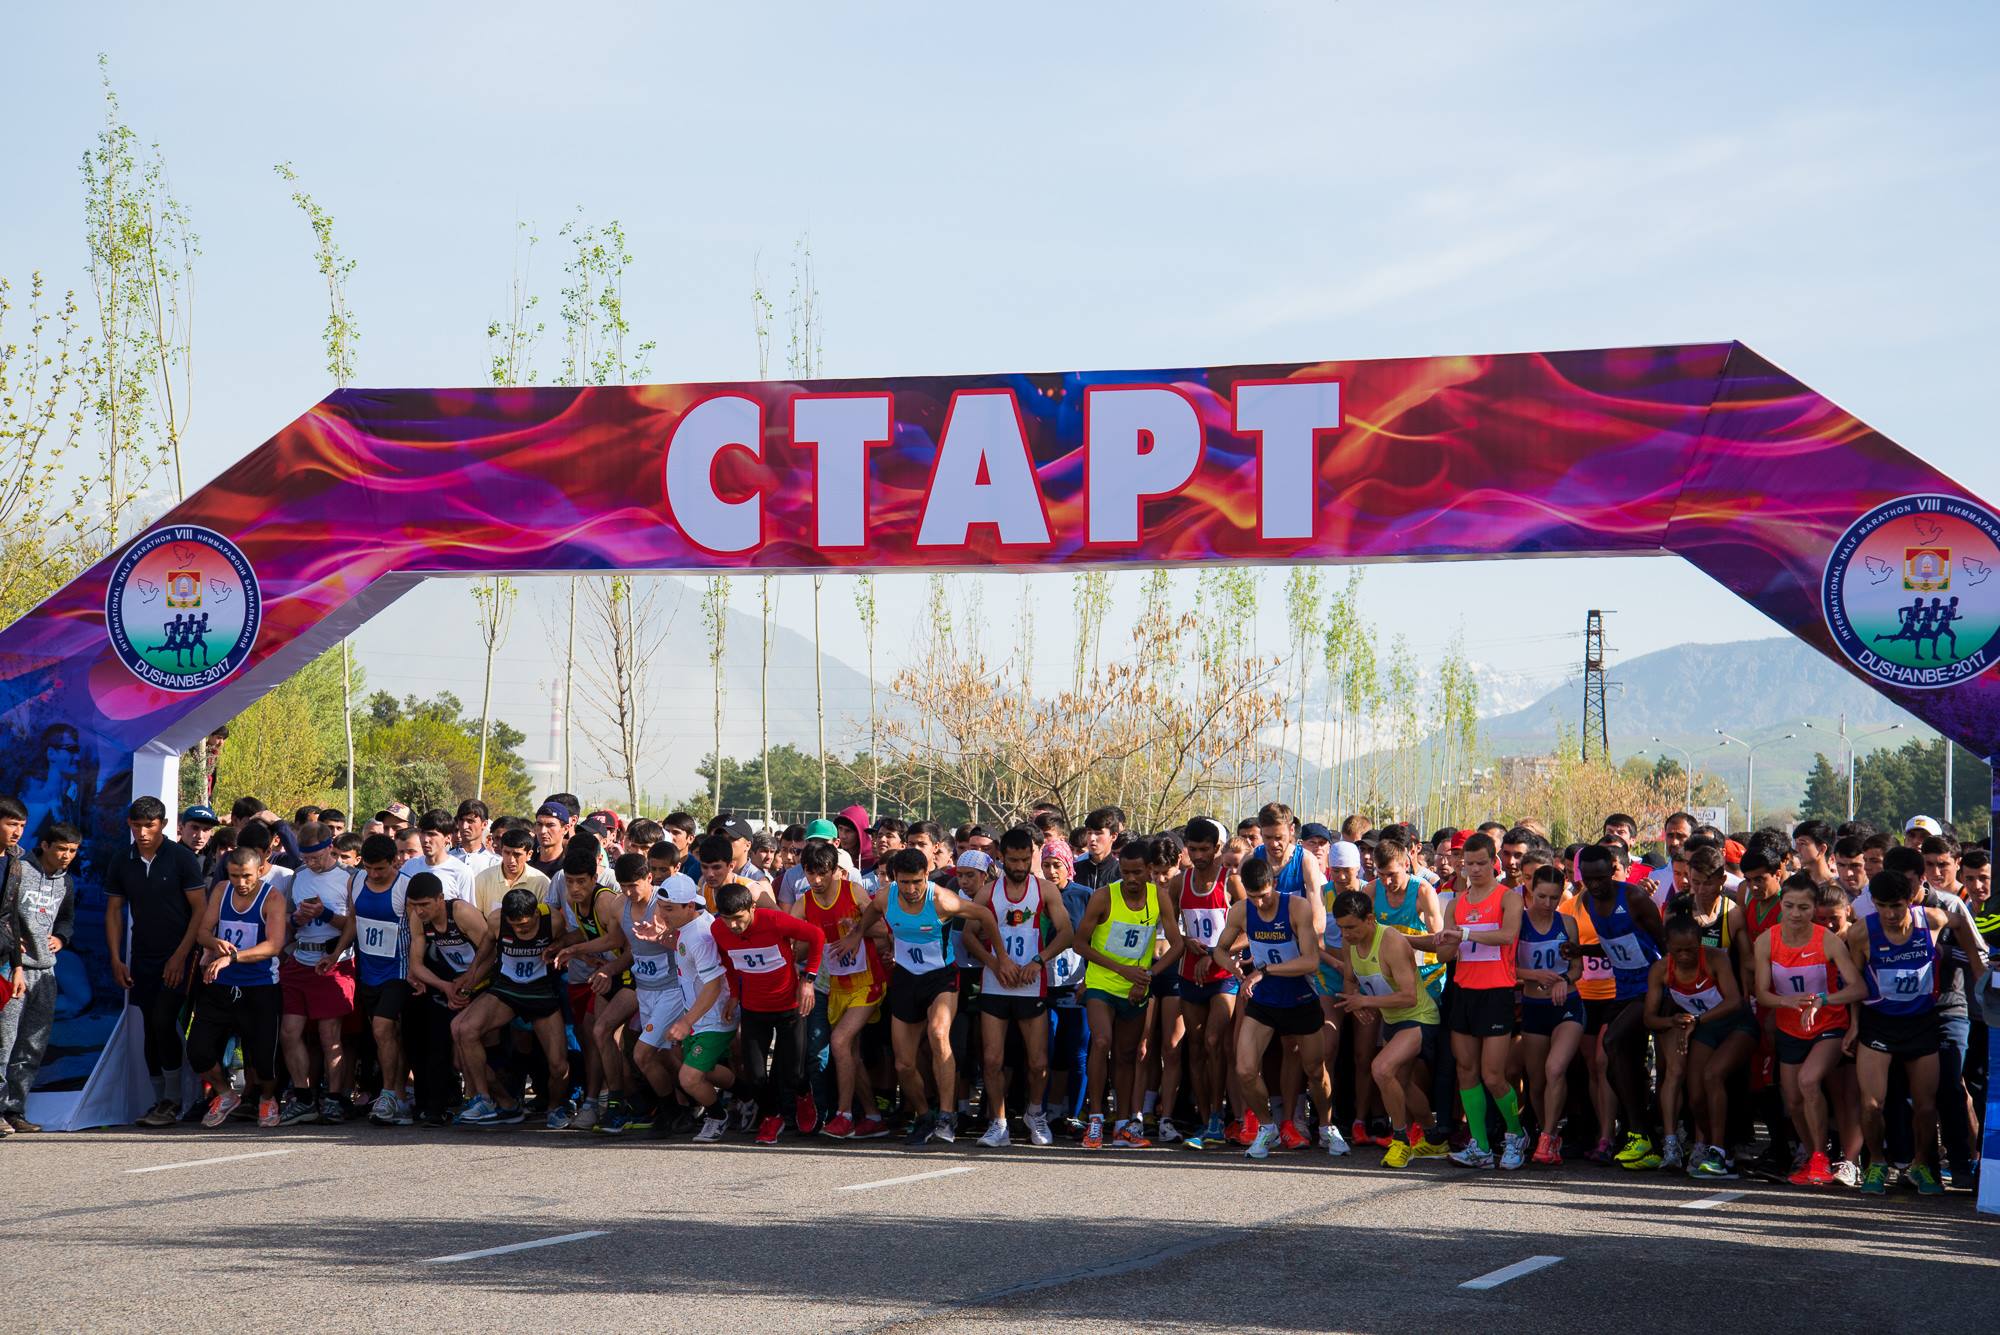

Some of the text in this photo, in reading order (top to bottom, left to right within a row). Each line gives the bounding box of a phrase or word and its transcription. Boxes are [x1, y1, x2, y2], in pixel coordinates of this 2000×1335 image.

[664, 380, 1342, 553] СТАРТ
[1916, 498, 1941, 512] VIII
[174, 529, 193, 540] VIII
[1830, 504, 1911, 641] INTERNATIONAL HALF MARATHON
[112, 534, 172, 652] INTERNATIONAL HALF MARATHON
[134, 656, 231, 688] DUSHANBE-2017
[1858, 649, 1987, 684] DUSHANBE-2017
[365, 927, 384, 947] 181
[1193, 918, 1213, 939] 19
[1005, 935, 1025, 957] 13
[1123, 929, 1140, 949] 15
[907, 947, 926, 965] 10
[1267, 948, 1283, 964] 6
[1533, 948, 1556, 970] 20
[1610, 943, 1632, 962] 12
[1880, 949, 1927, 964] TAJIKISTAN
[1788, 975, 1805, 993] 17
[1894, 976, 1919, 994] 222
